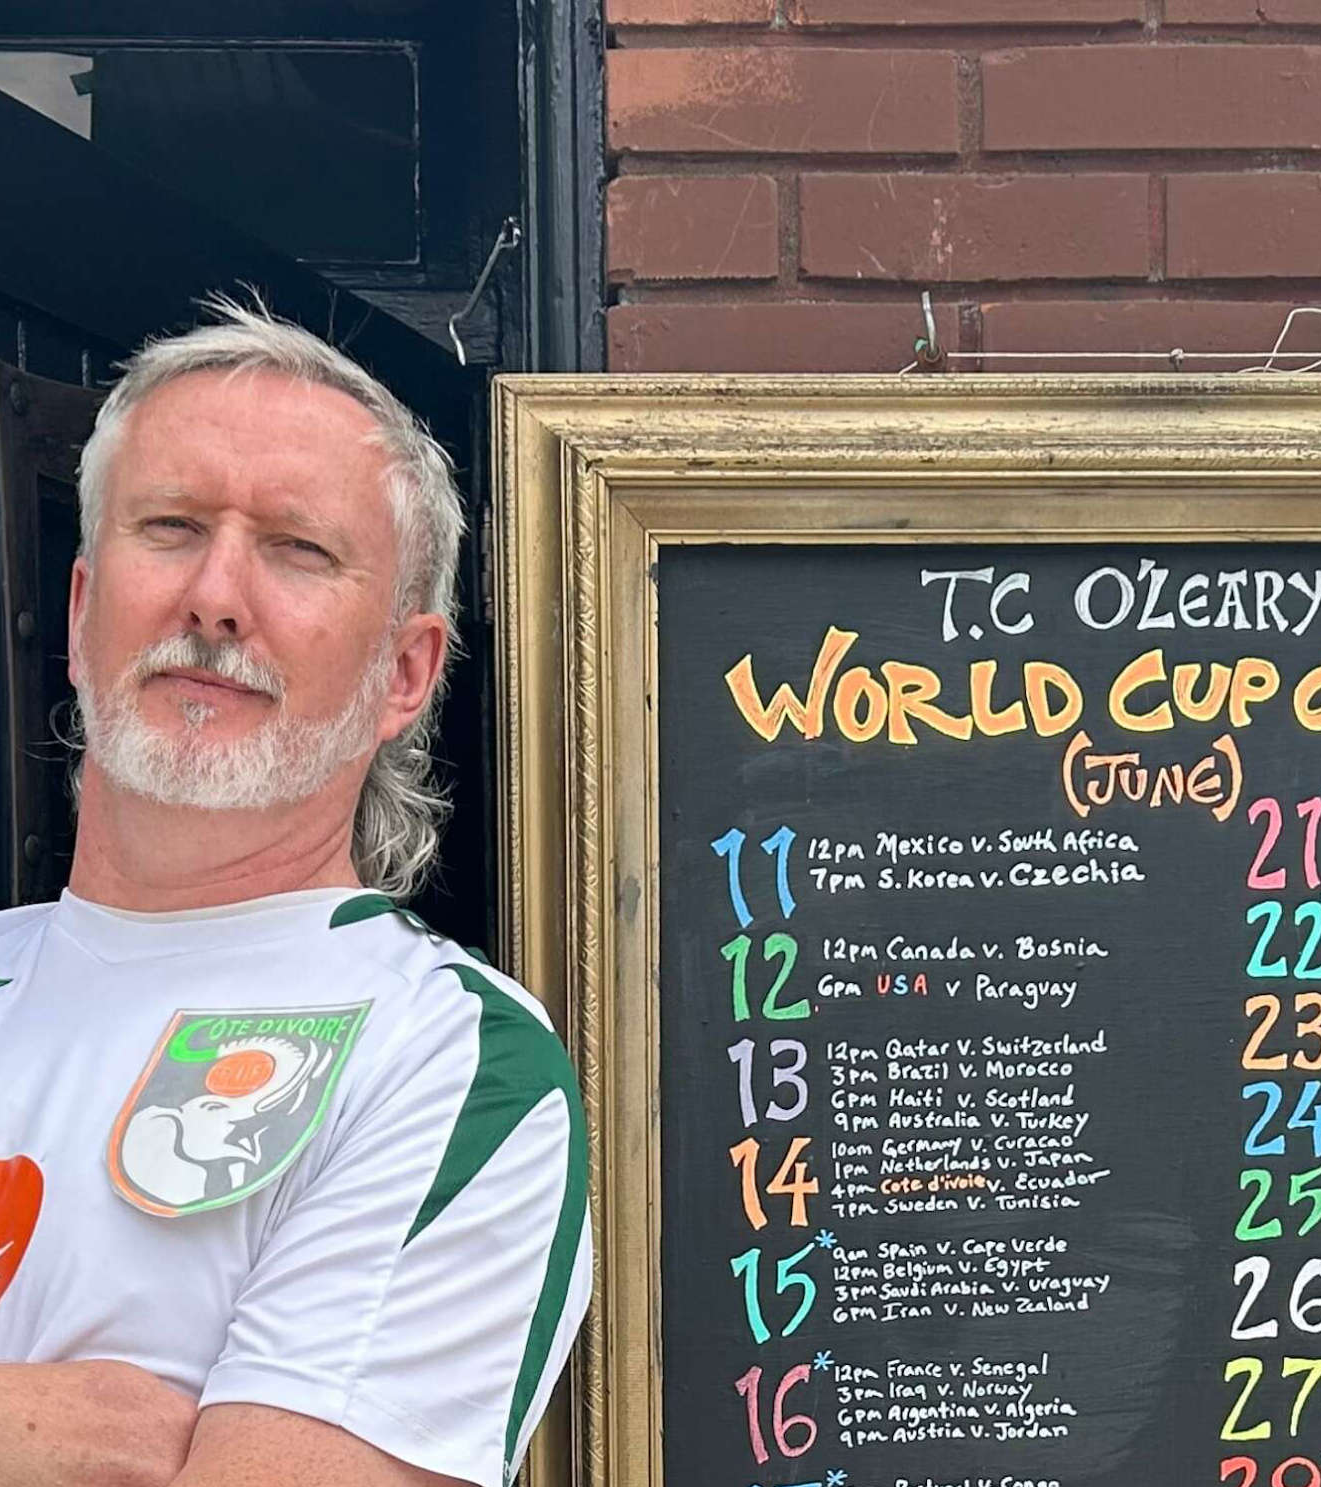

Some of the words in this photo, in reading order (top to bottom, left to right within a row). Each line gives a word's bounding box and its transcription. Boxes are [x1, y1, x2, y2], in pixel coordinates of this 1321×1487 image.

[724, 625, 1087, 748] WORLD
[1108, 648, 1281, 732] CUP
[1062, 730, 1243, 823] (JUNE)
[710, 825, 797, 929] 11
[875, 832, 964, 865] Mexico
[998, 828, 1058, 853] South
[1062, 829, 1140, 856] Africa
[1009, 858, 1146, 887] Czechia
[720, 932, 811, 1022] 12
[886, 935, 976, 961] Canada
[1015, 935, 1109, 960] Bosnia
[877, 973, 928, 996] USA
[976, 973, 1078, 1010] Paraguay
[727, 1038, 808, 1128] 13
[885, 1038, 950, 1060] Qatar
[981, 1029, 1108, 1057] Switzerland
[887, 1061, 949, 1081] Brazil
[985, 1060, 1073, 1080] Morocco
[889, 1087, 943, 1108] Haiti
[984, 1083, 1074, 1109] Scotland
[888, 1110, 981, 1129] Australia
[1014, 1111, 1090, 1138] Turkey
[729, 1137, 820, 1231] 14
[881, 1137, 963, 1163] Germany
[993, 1135, 1074, 1151] Curacao
[879, 1153, 992, 1175] Netherlands
[1023, 1149, 1094, 1168] Japan
[1014, 1169, 1111, 1191] Ecuador
[730, 1242, 817, 1345] 15
[877, 1242, 928, 1261] Spain
[962, 1239, 1007, 1258] Cape
[882, 1260, 954, 1283] Belgium
[984, 1256, 1051, 1278] Egypt
[735, 1364, 818, 1465] 16
[887, 1359, 943, 1379] France
[971, 1352, 1049, 1383] Senegal
